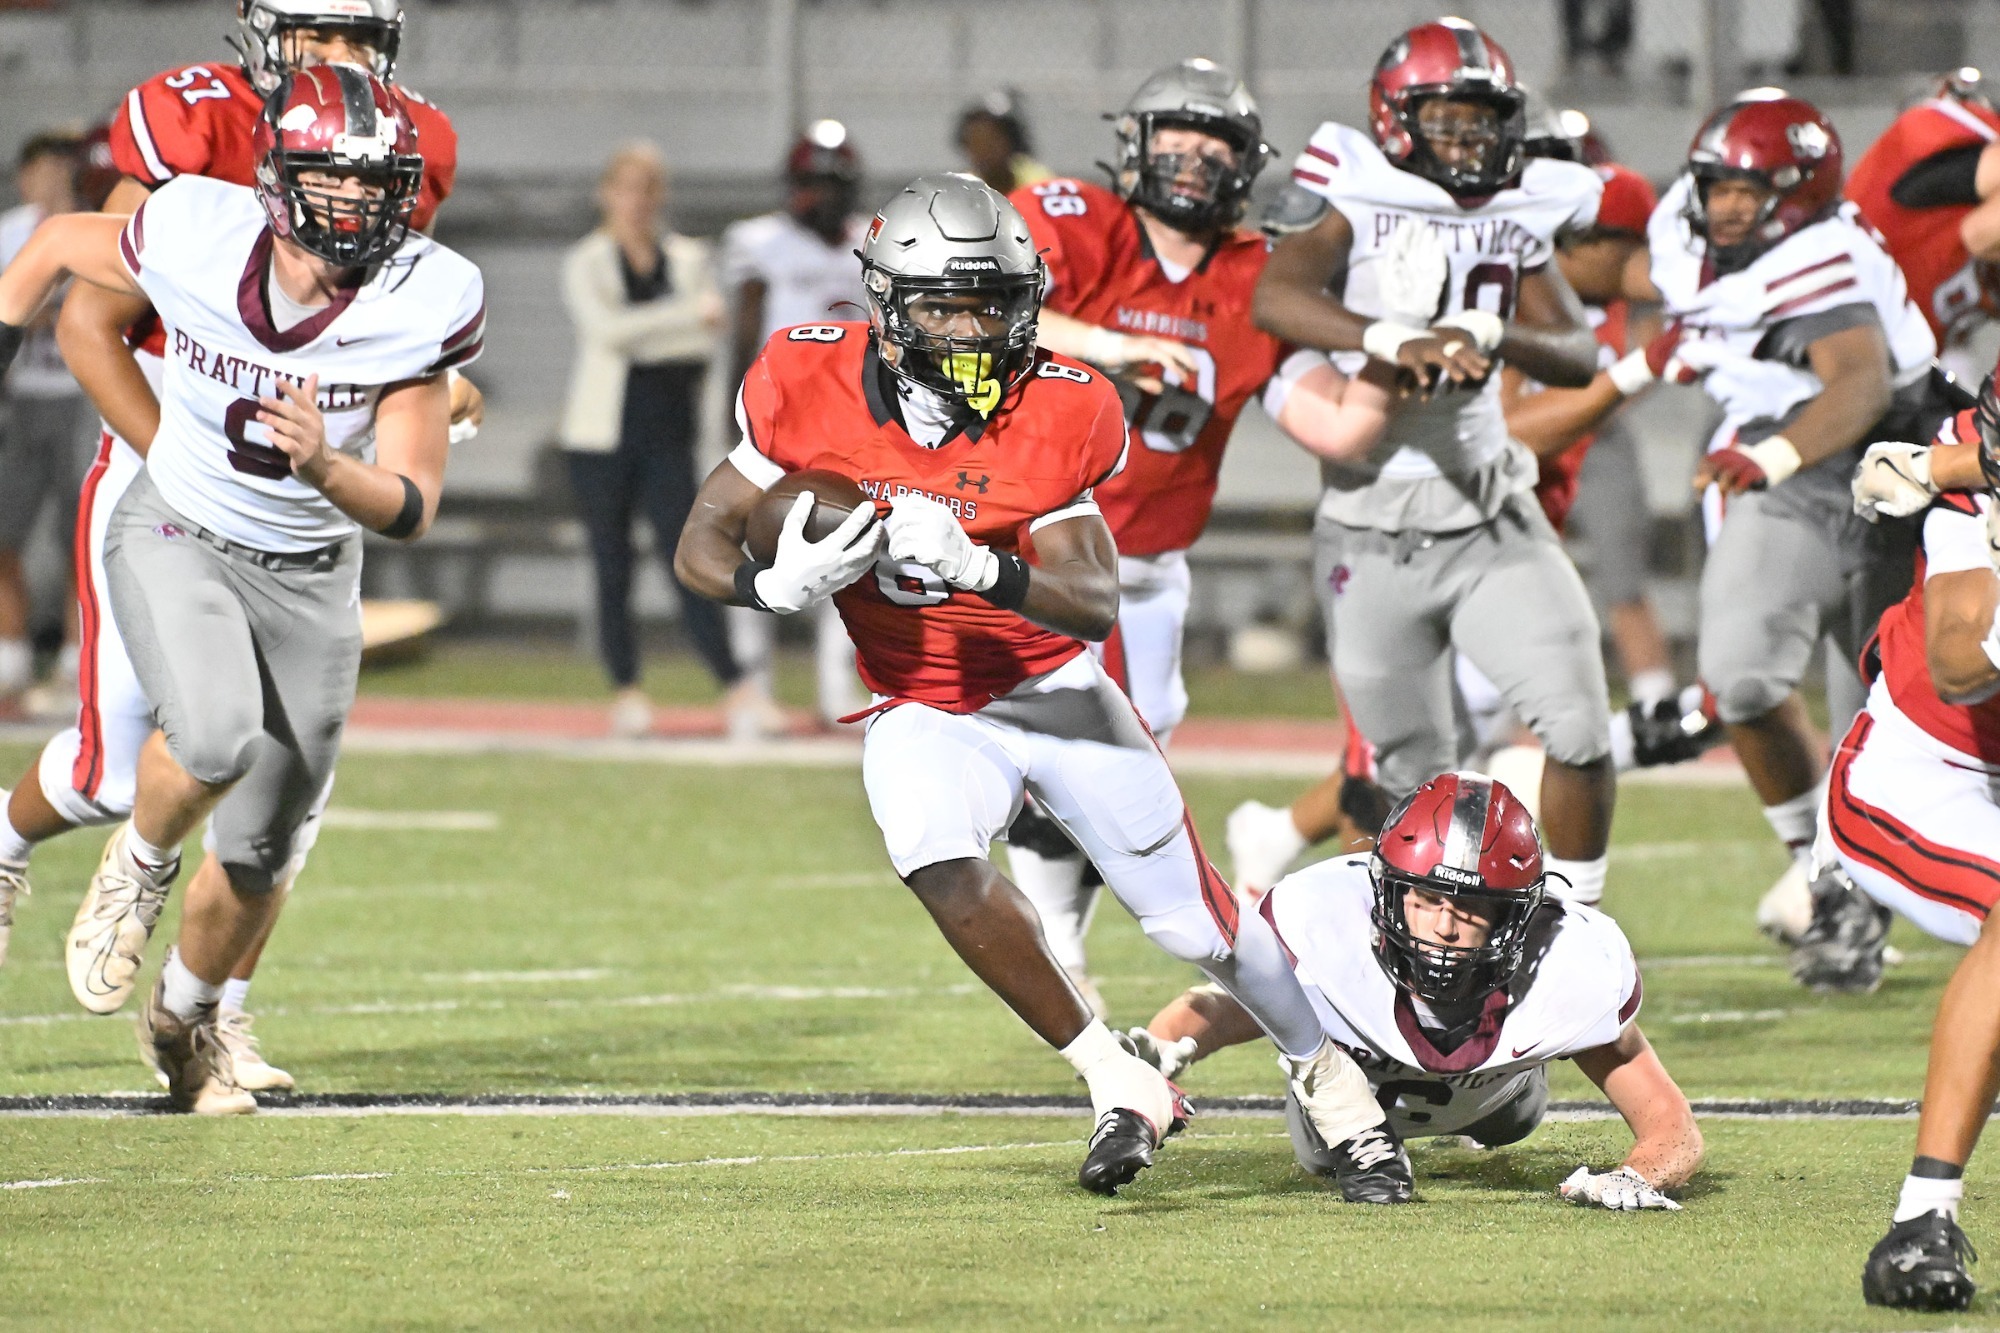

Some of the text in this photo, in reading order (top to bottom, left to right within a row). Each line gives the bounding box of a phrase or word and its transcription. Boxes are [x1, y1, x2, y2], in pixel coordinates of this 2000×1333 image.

[165, 66, 231, 105] 57
[950, 259, 998, 271] Riddell
[787, 325, 846, 343] 8
[1036, 361, 1093, 385] 8
[1434, 866, 1480, 886] Riddell
